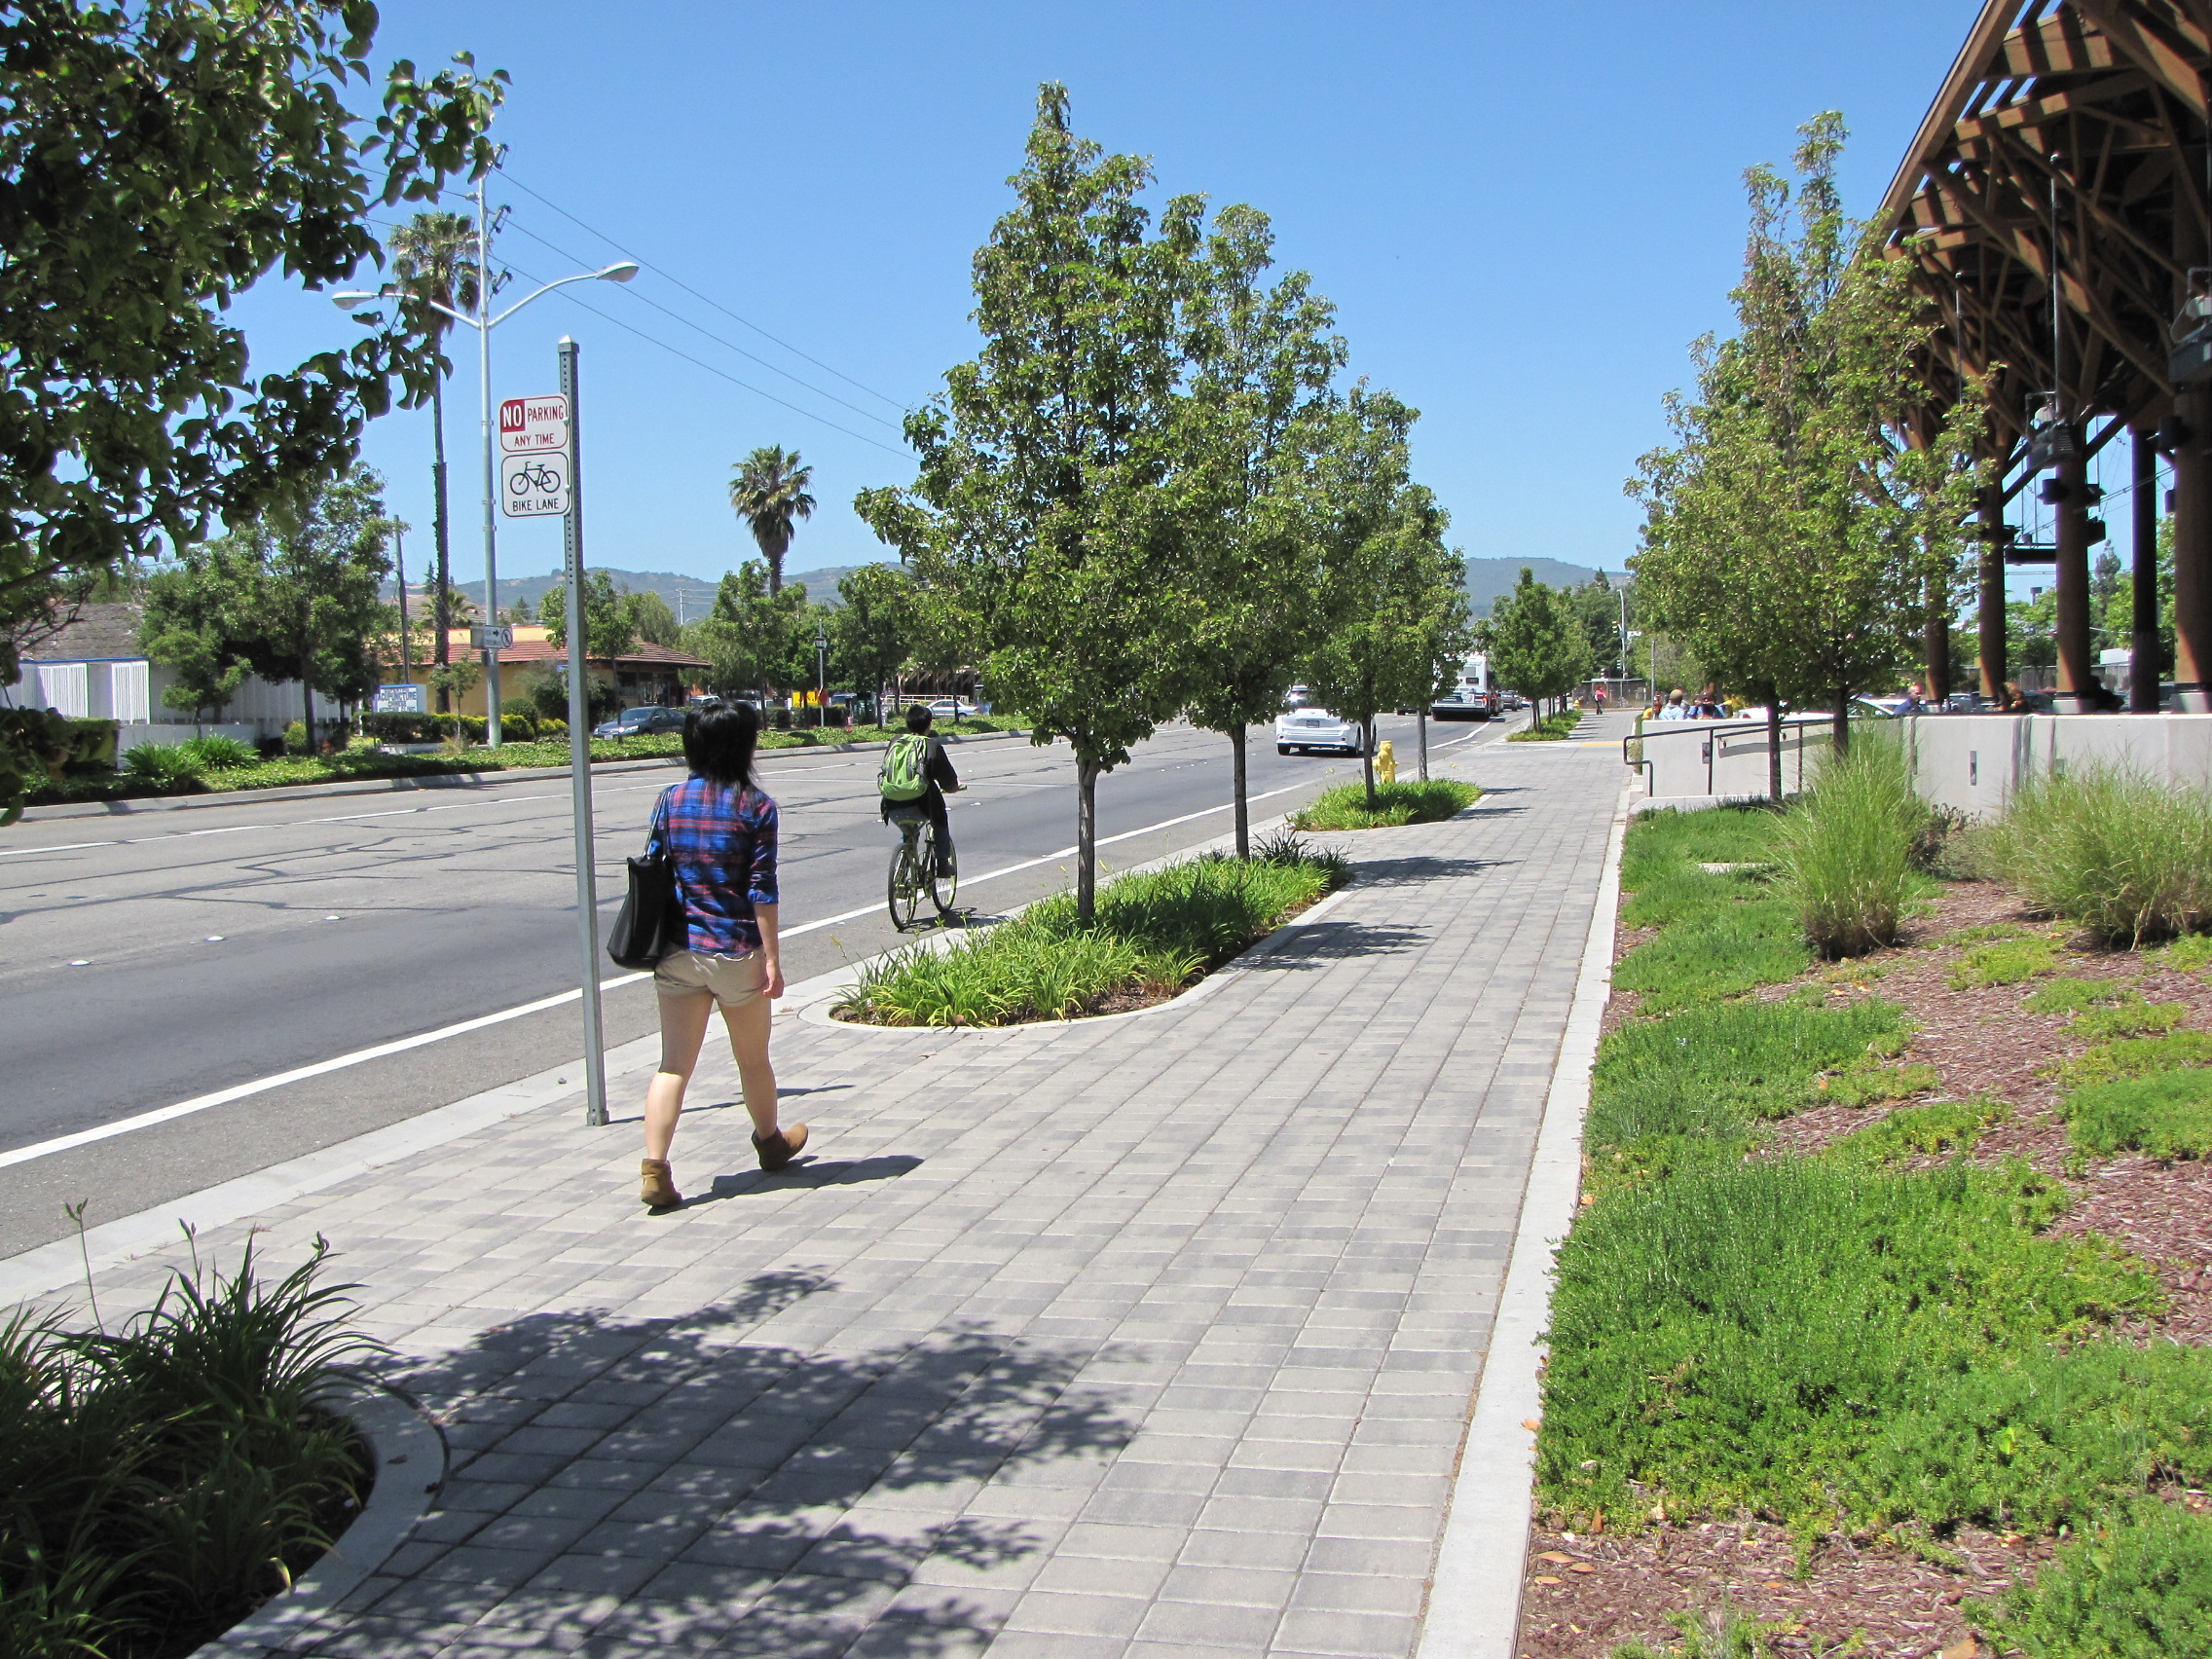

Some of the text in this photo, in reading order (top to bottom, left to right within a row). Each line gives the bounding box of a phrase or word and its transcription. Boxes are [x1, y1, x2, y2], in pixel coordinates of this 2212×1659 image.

[503, 405, 564, 427] NO PARKING
[514, 433, 555, 447] ANY TIME
[512, 498, 559, 512] BIKE LANE
